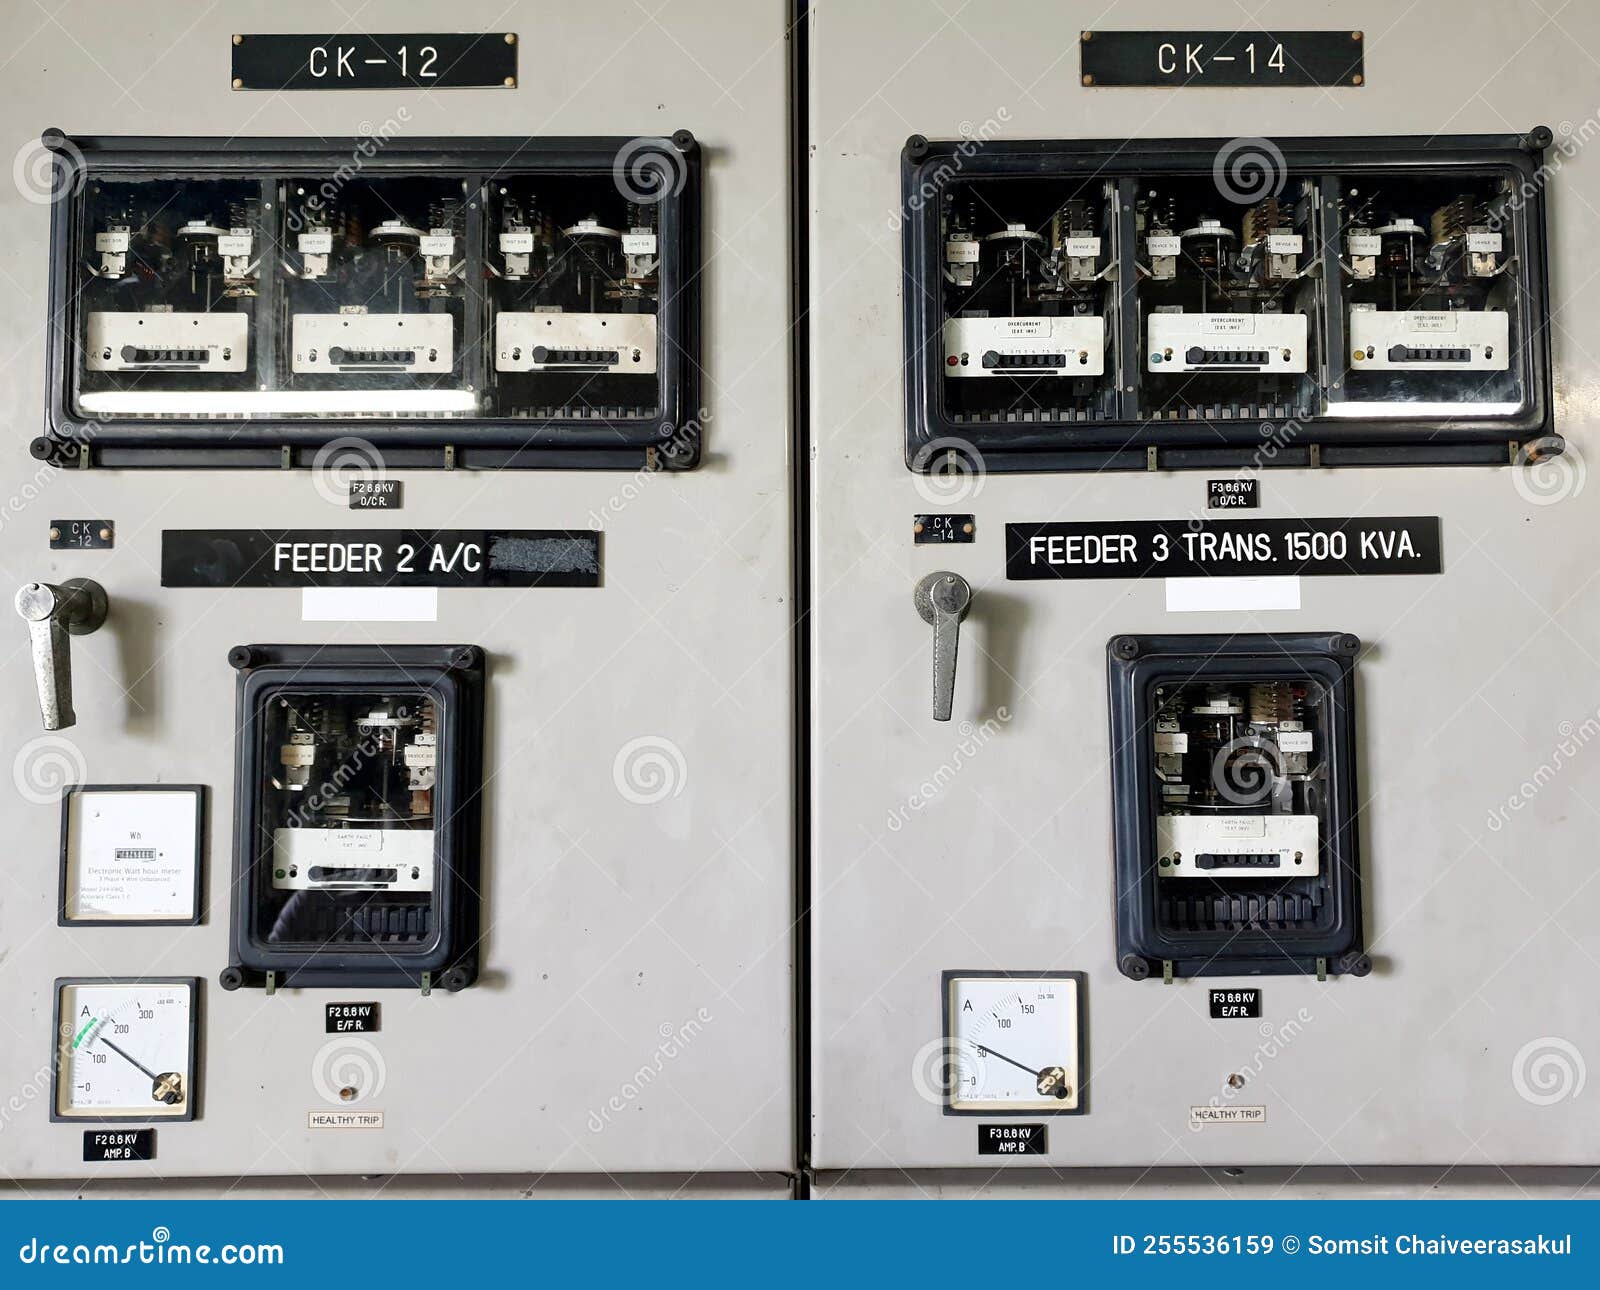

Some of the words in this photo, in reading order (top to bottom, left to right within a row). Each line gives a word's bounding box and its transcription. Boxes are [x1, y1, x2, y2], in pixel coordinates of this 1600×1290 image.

[309, 45, 438, 78] CK-12
[1158, 43, 1285, 74] CK-14
[353, 483, 365, 493] F2
[382, 483, 394, 493] KV
[1211, 483, 1224, 493] F3
[1241, 482, 1253, 492] KV
[1029, 534, 1138, 565] FEEDER
[1152, 533, 1169, 562] 3
[1182, 531, 1278, 562] TRANS.
[1284, 530, 1347, 561] 1500
[1360, 529, 1421, 560] KVA.
[274, 543, 383, 573] FEEDER
[396, 543, 415, 573] 2
[428, 542, 481, 573] A/C
[1213, 992, 1226, 1003] F3
[1242, 992, 1255, 1003] KV
[80, 1005, 91, 1017] A
[963, 999, 973, 1012] A
[1020, 1004, 1035, 1015] 150
[138, 1009, 154, 1020] 300
[329, 1007, 341, 1017] F2
[358, 1006, 371, 1016] KV
[113, 1024, 129, 1034] 200
[997, 1018, 1012, 1029] 100
[976, 1048, 987, 1058] 50
[92, 1054, 107, 1064] 100
[970, 1076, 977, 1086] 0
[85, 1082, 91, 1092] 0
[312, 1116, 356, 1124] HEALTHY
[358, 1116, 379, 1124] TRIP
[1195, 1111, 1238, 1119] HEALTHY
[1240, 1110, 1262, 1119] TRIP
[990, 1128, 1002, 1139] F3
[1003, 1128, 1018, 1139] 6.6
[1018, 1128, 1031, 1139] KV
[95, 1134, 108, 1145] F2
[109, 1134, 124, 1145] 6.6
[124, 1134, 138, 1145] KV
